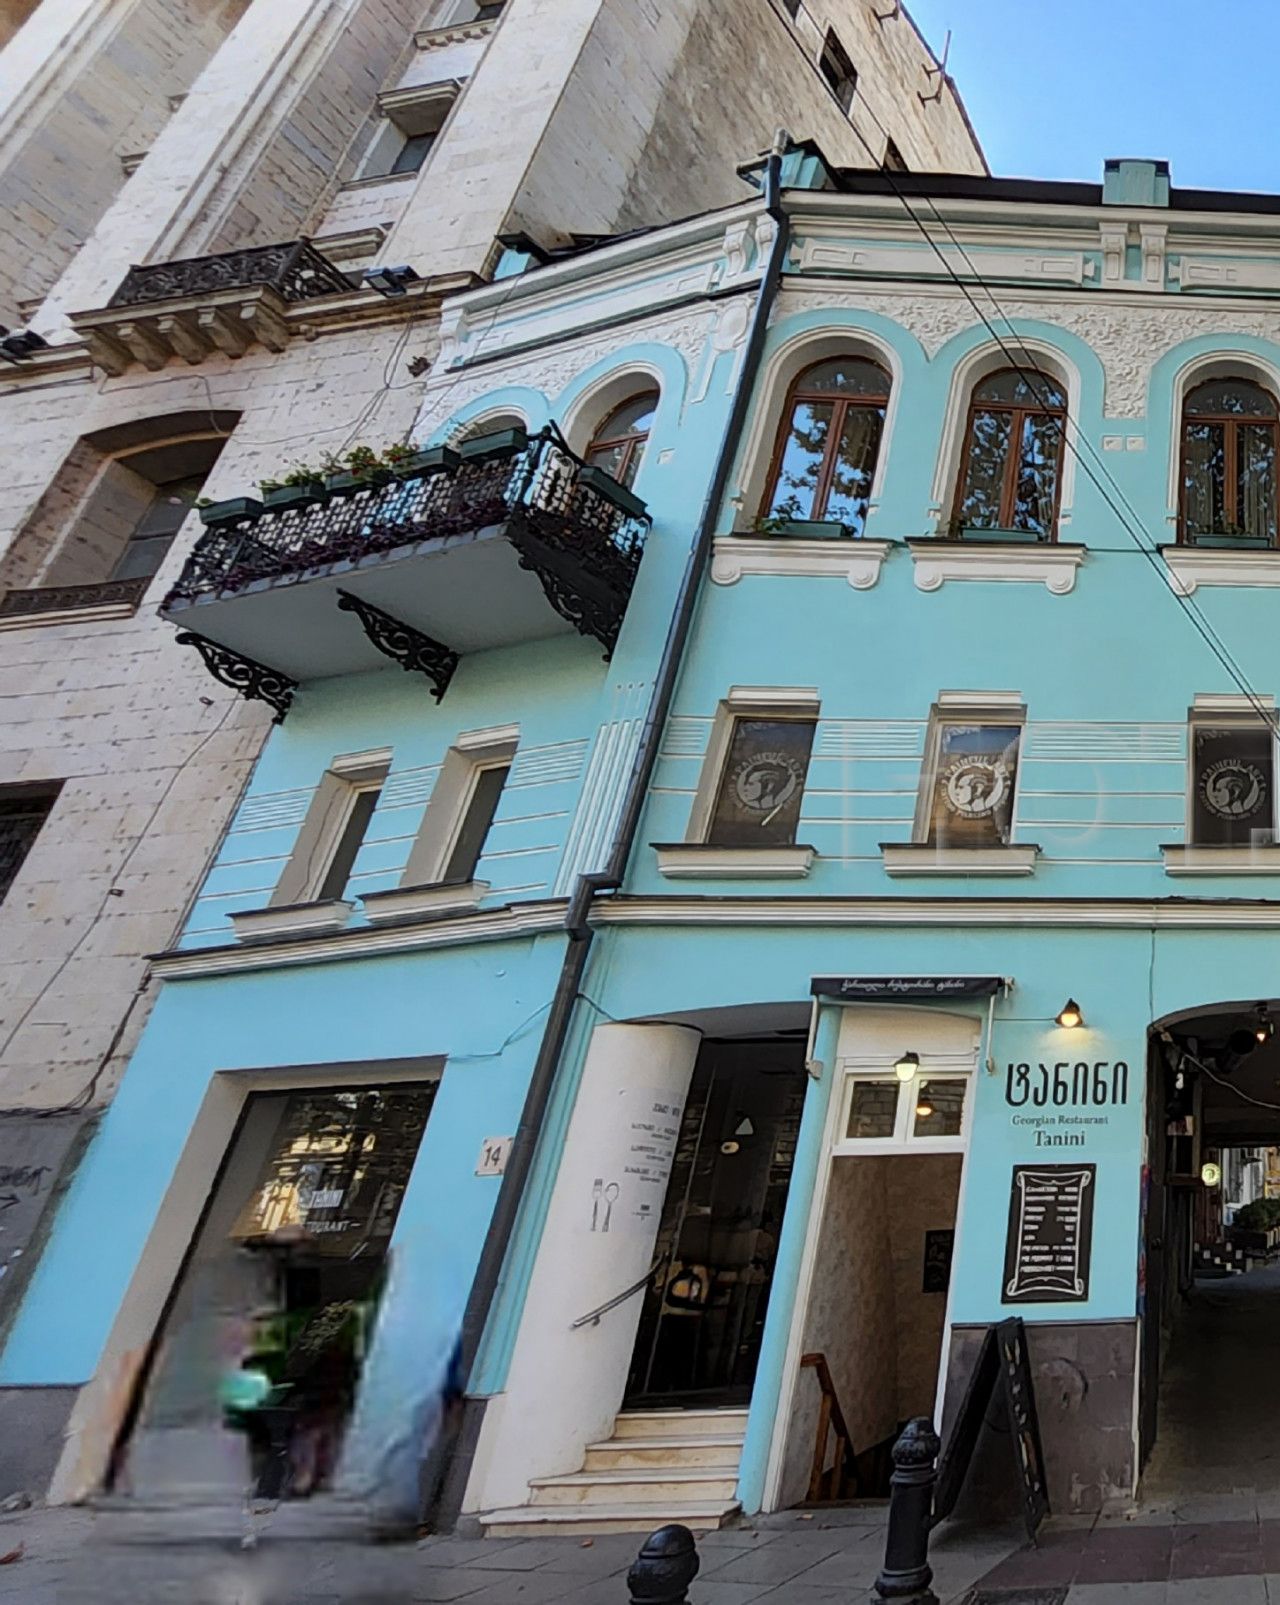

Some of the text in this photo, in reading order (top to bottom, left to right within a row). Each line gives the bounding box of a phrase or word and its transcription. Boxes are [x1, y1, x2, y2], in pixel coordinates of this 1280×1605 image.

[1201, 758, 1243, 781] PAINFUL
[1005, 1061, 1128, 1107] ტანინი
[1012, 1114, 1109, 1127] Georgian Restaurant
[1033, 1129, 1086, 1147] Tanini
[484, 1145, 502, 1167] 14
